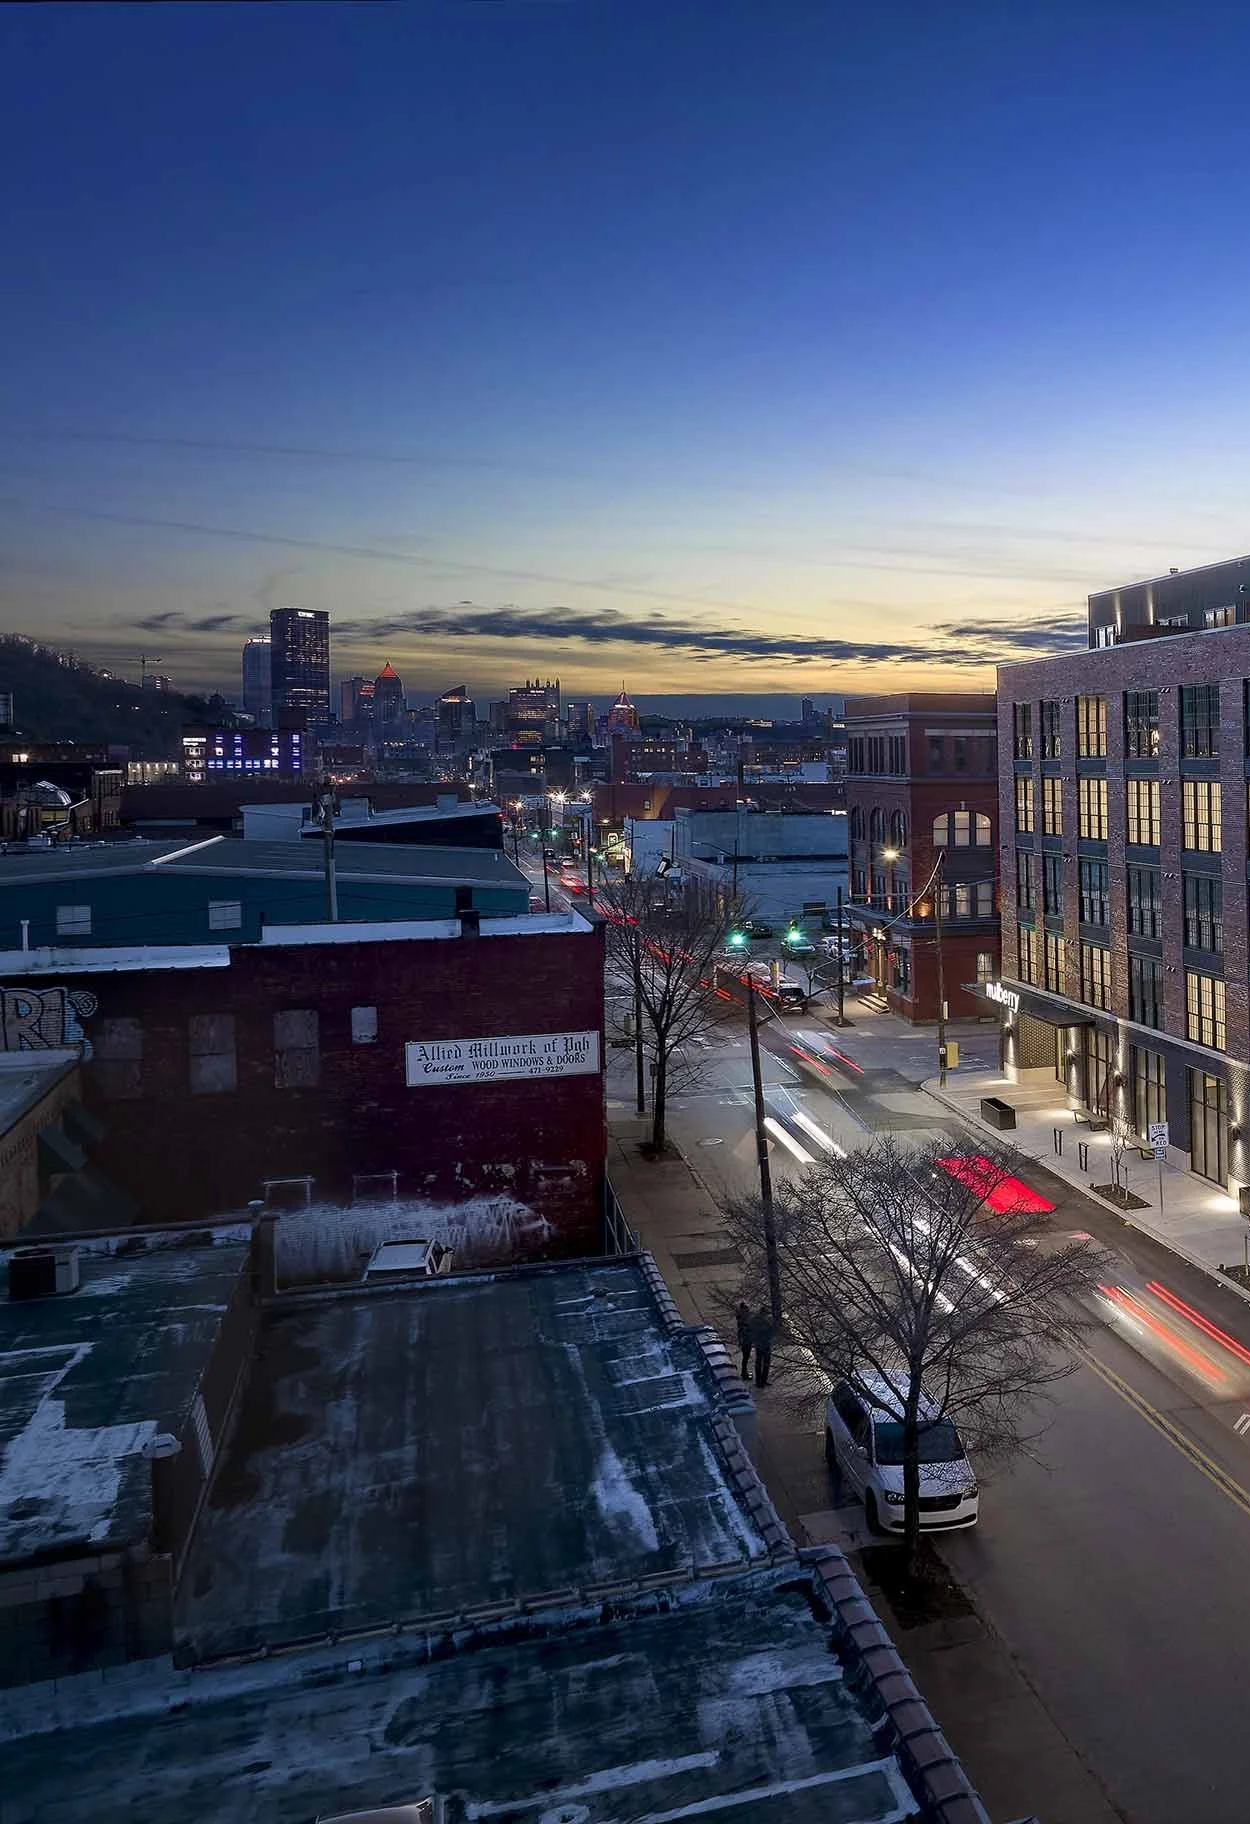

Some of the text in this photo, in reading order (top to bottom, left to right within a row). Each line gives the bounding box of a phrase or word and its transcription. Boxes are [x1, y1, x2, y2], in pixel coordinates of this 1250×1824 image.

[986, 982, 1020, 1014] mulberry
[417, 1037, 590, 1061] Allied Millwork of Pgh
[423, 1053, 586, 1074] Custom WOOD WINDOWS & DOORS
[445, 1072, 471, 1080] Since
[475, 1070, 496, 1078] 1950
